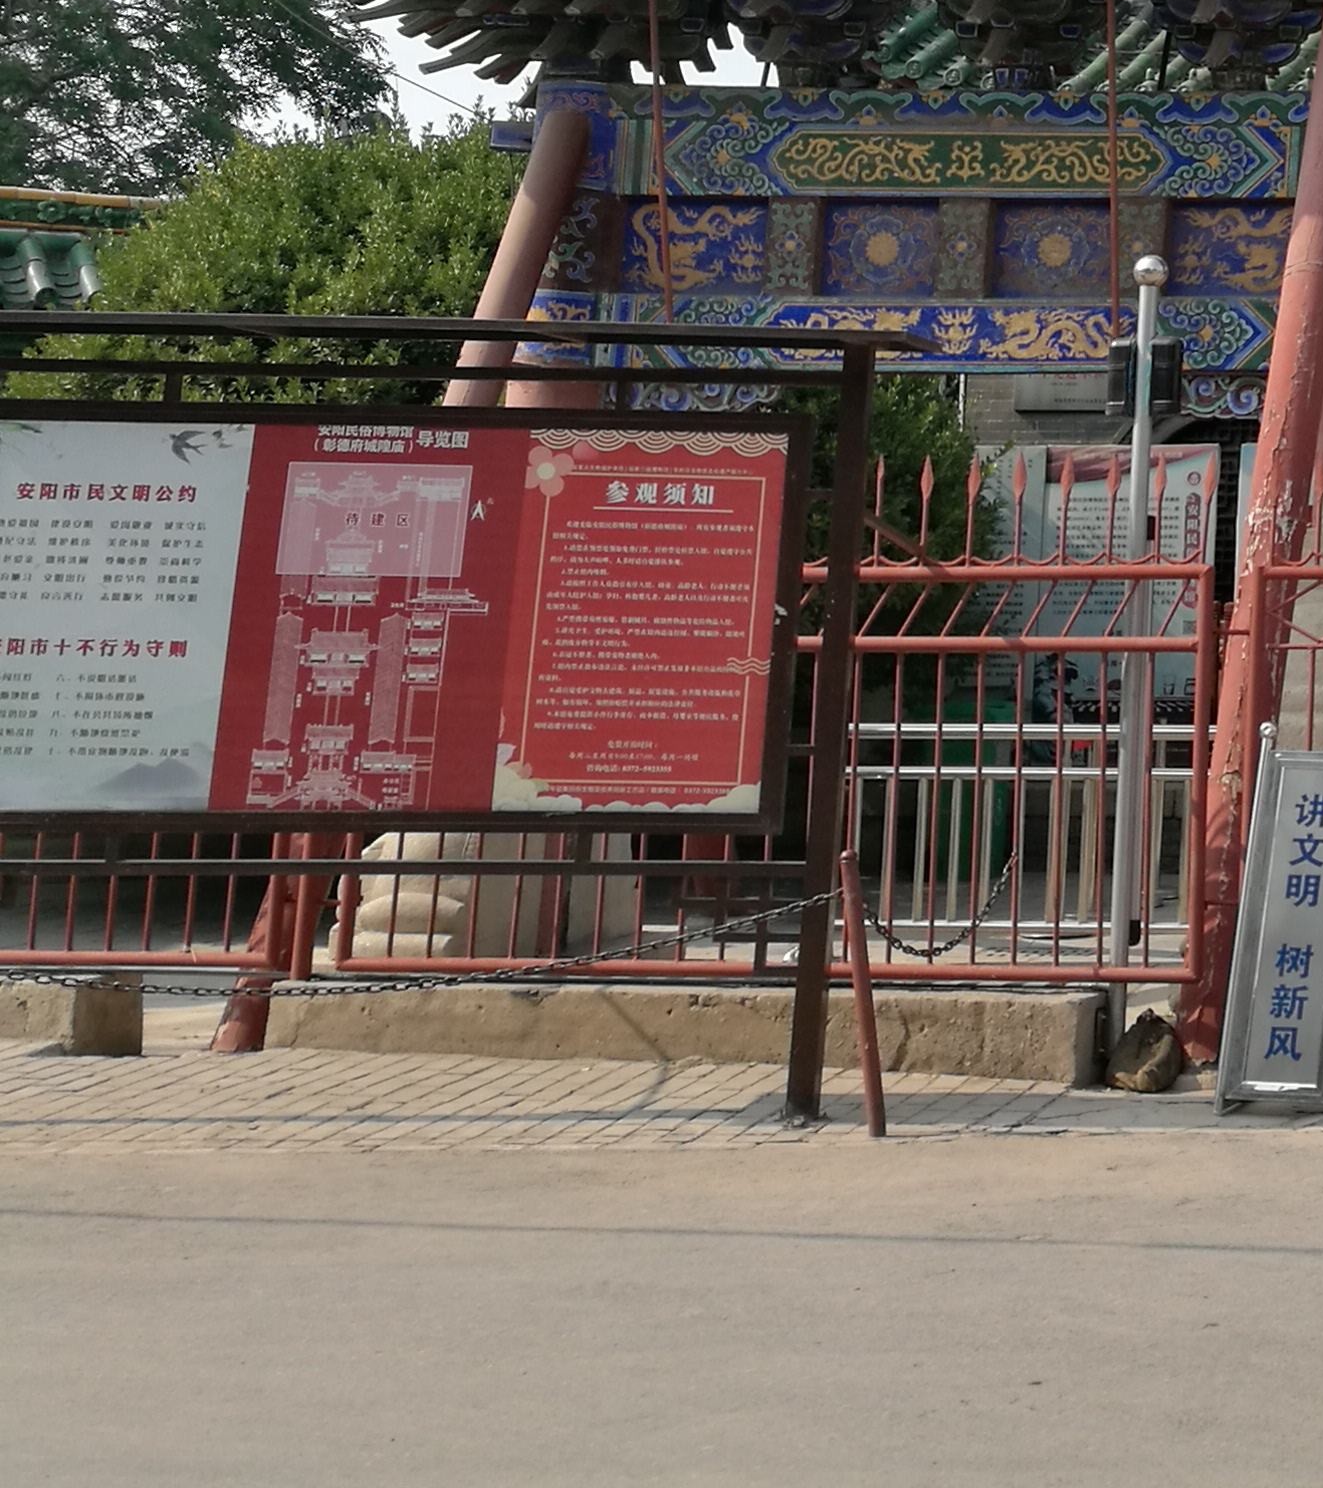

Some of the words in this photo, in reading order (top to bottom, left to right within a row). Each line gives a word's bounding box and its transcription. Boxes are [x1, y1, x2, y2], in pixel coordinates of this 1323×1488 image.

[416, 430, 469, 448] 导览图
[16, 482, 198, 502] 安阳市民文明公约
[605, 480, 715, 506] 参观须知
[346, 513, 411, 526] 待建区
[0, 638, 189, 658] 阳市十不行为守则
[1264, 943, 1314, 1061] 树新风
